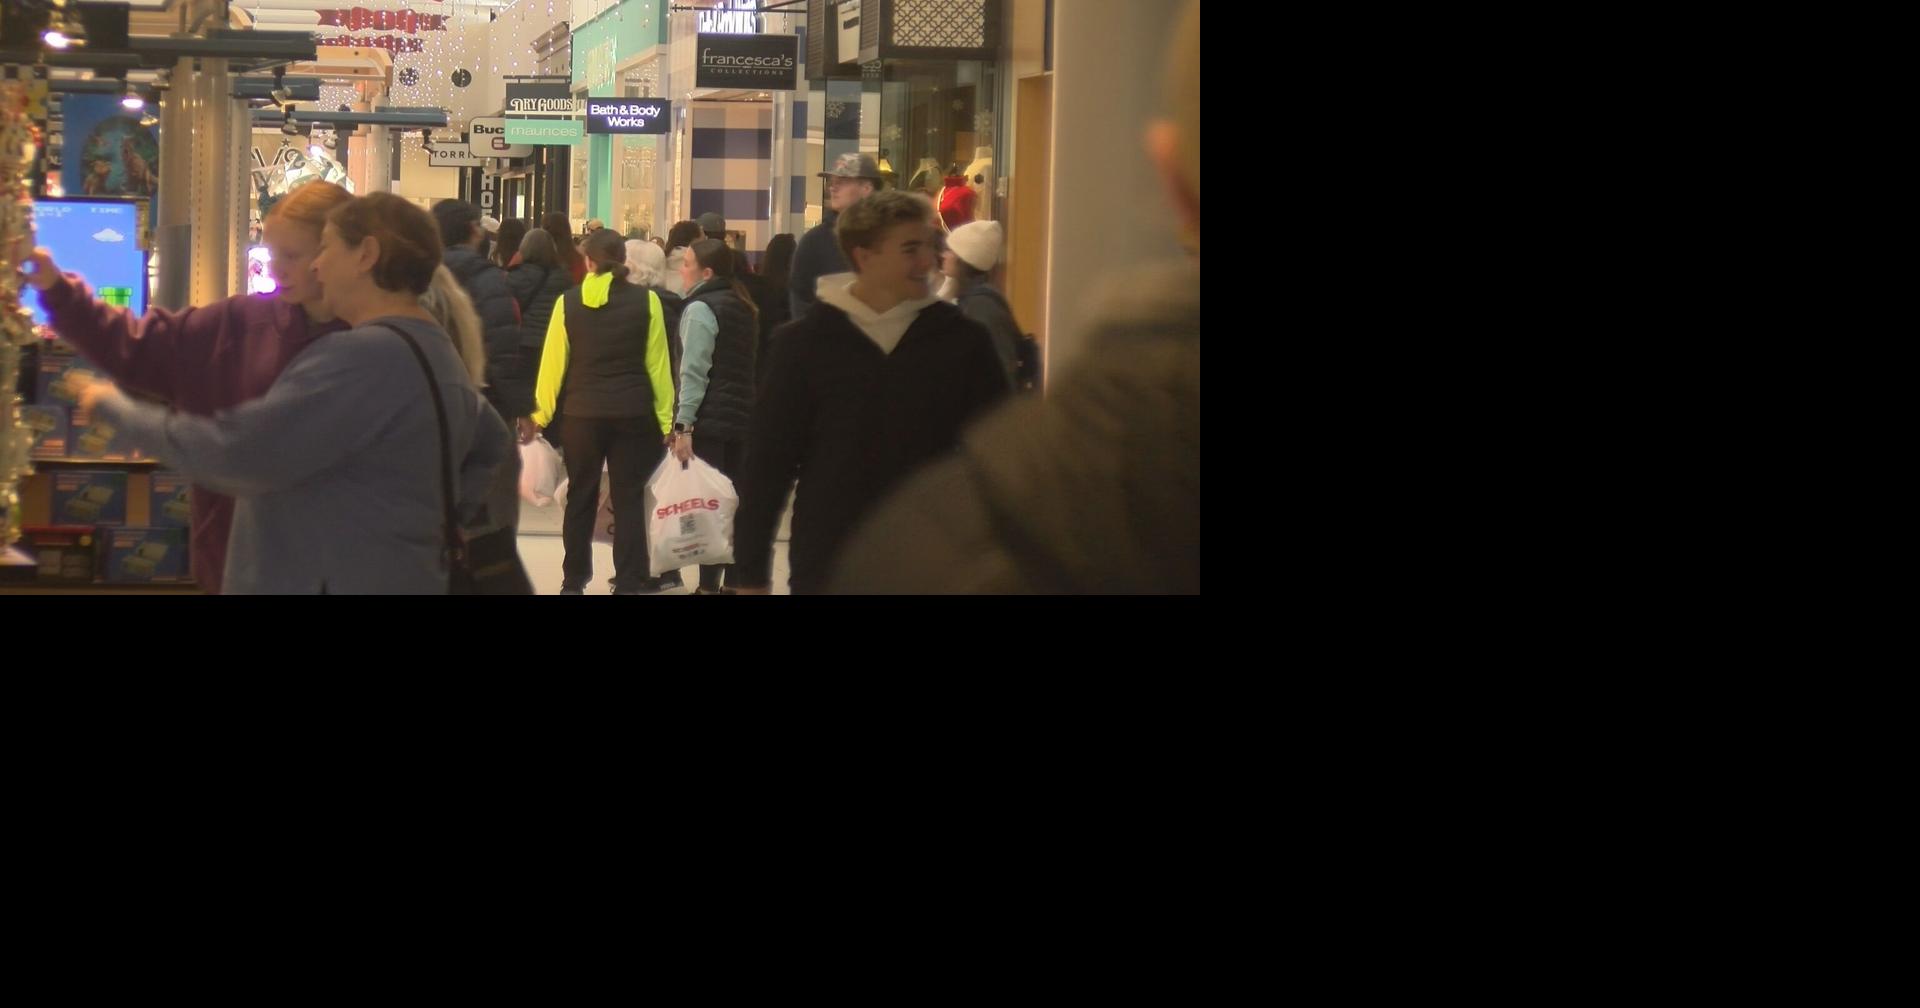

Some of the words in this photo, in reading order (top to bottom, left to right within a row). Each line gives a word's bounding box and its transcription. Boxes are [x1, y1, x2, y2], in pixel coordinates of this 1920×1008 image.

[702, 47, 793, 67] francesca's
[710, 68, 784, 76] COLLECTIONS
[510, 98, 537, 112] DRY
[538, 98, 573, 112] GOODS
[590, 105, 619, 115] Bath
[619, 105, 629, 115] &
[630, 105, 661, 118] Body
[607, 117, 645, 127] Works
[473, 124, 505, 134] Buc
[511, 126, 578, 137] maurices
[433, 150, 478, 159] TORRI
[656, 497, 720, 520] SCHEELS
